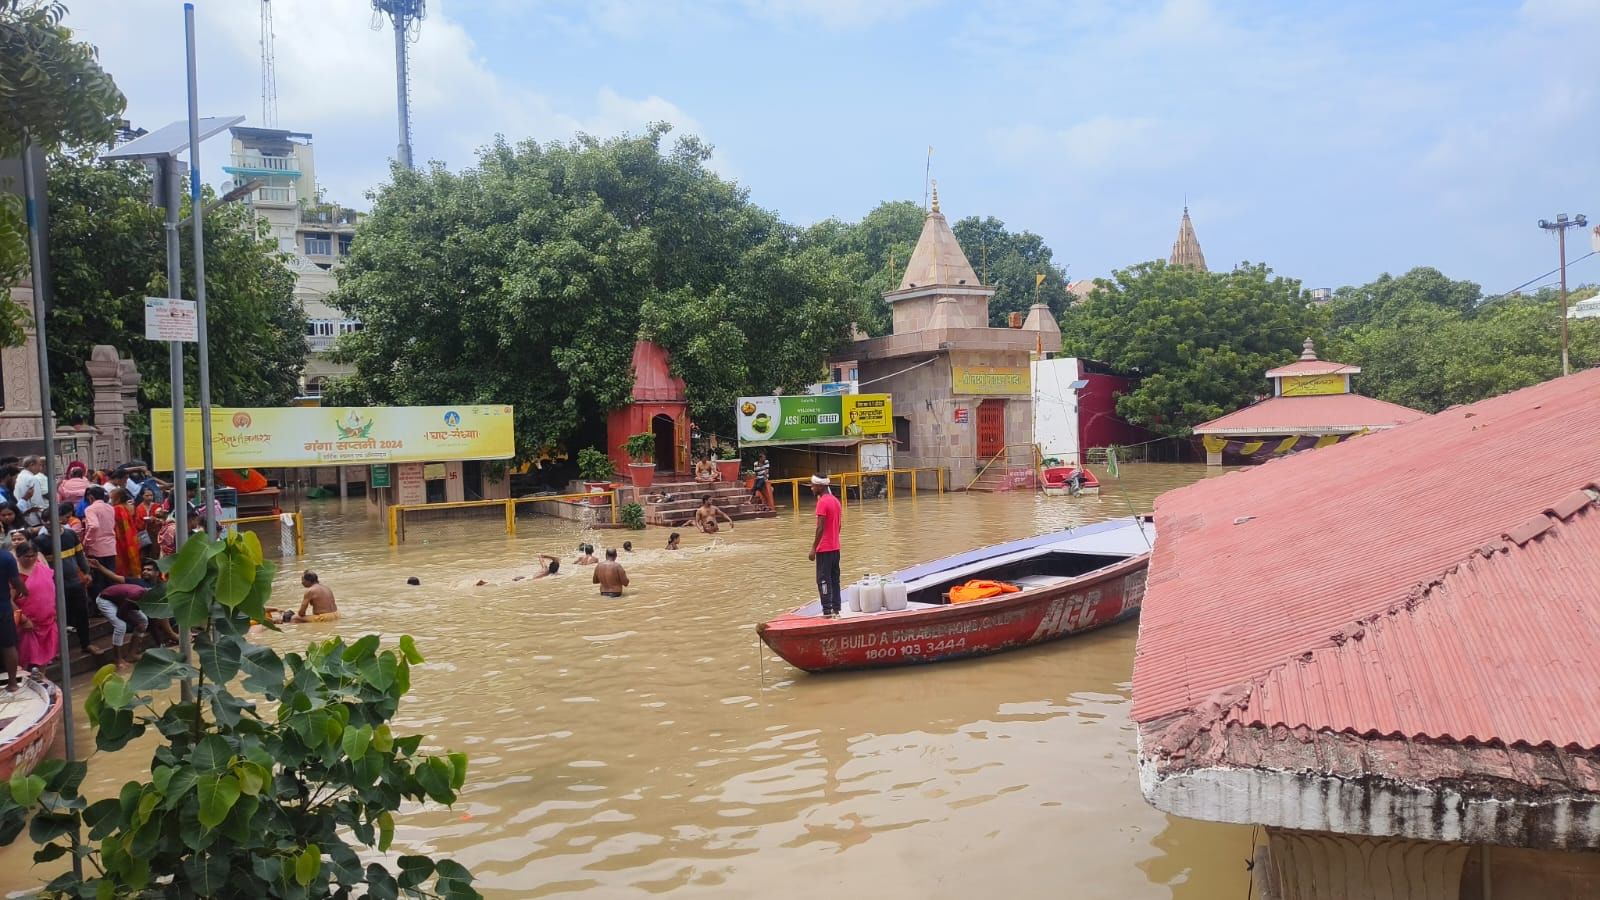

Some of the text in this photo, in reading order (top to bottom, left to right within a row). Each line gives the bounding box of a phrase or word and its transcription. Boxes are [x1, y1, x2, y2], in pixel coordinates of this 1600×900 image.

[784, 414, 837, 426] ASSI FOOD STREET
[303, 437, 403, 451] गंगा सप्तमी 2024
[841, 635, 877, 650] BUILD
[879, 632, 889, 645] A
[865, 637, 966, 660] 1800 103 3444
